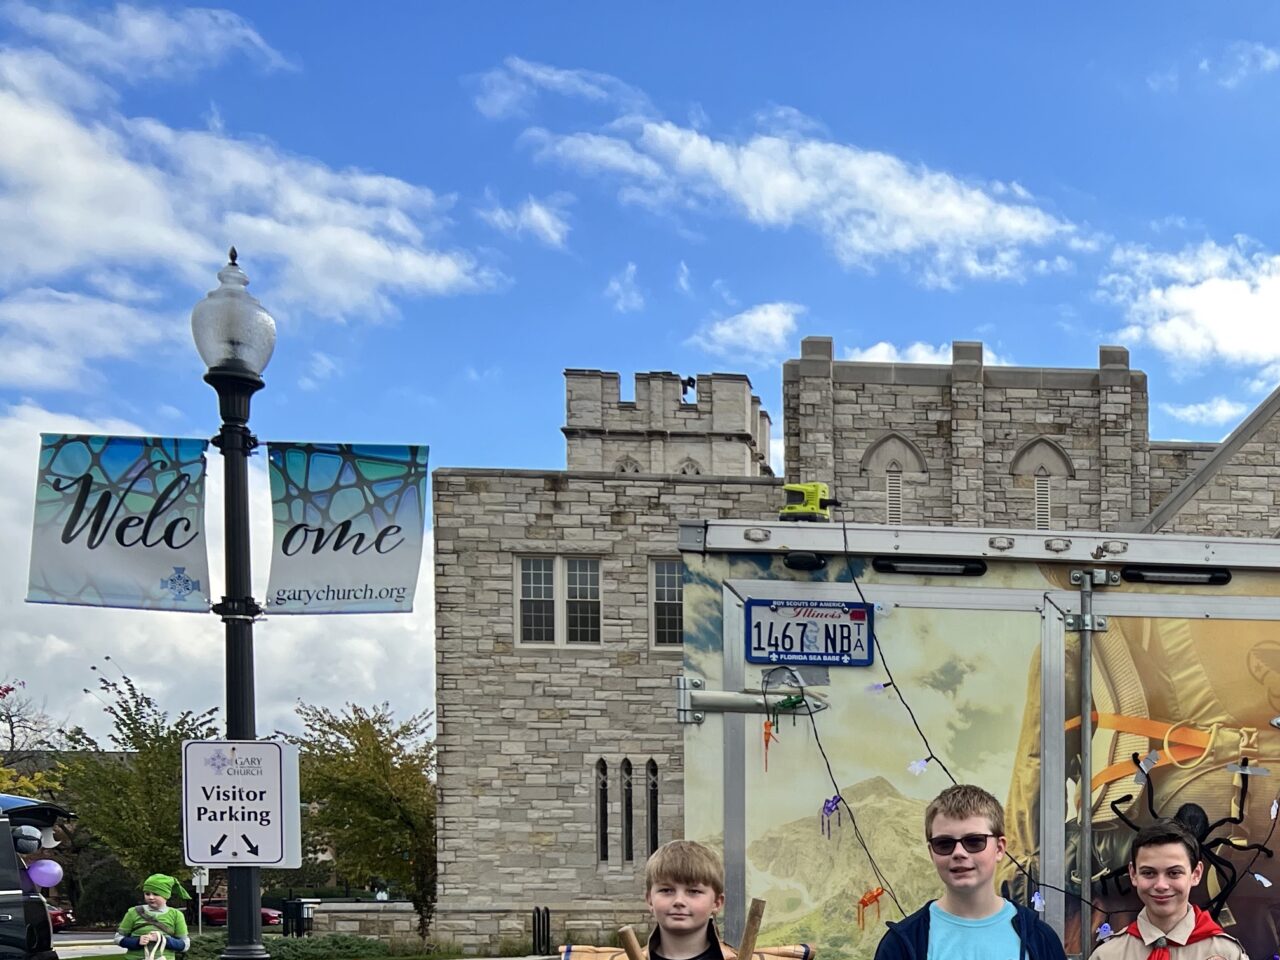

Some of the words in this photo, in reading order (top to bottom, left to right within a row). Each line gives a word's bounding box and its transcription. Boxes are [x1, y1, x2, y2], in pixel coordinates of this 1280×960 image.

[53, 460, 200, 550] Welc
[281, 519, 405, 557] ome
[276, 584, 407, 602] garychurch.org
[792, 607, 843, 619] Illinois
[753, 621, 808, 652] 1467
[825, 624, 852, 653] NB
[779, 653, 808, 661] FLORIDA
[226, 768, 264, 776] CHURCH
[201, 785, 267, 802] Visitor
[196, 805, 271, 827] Parking
